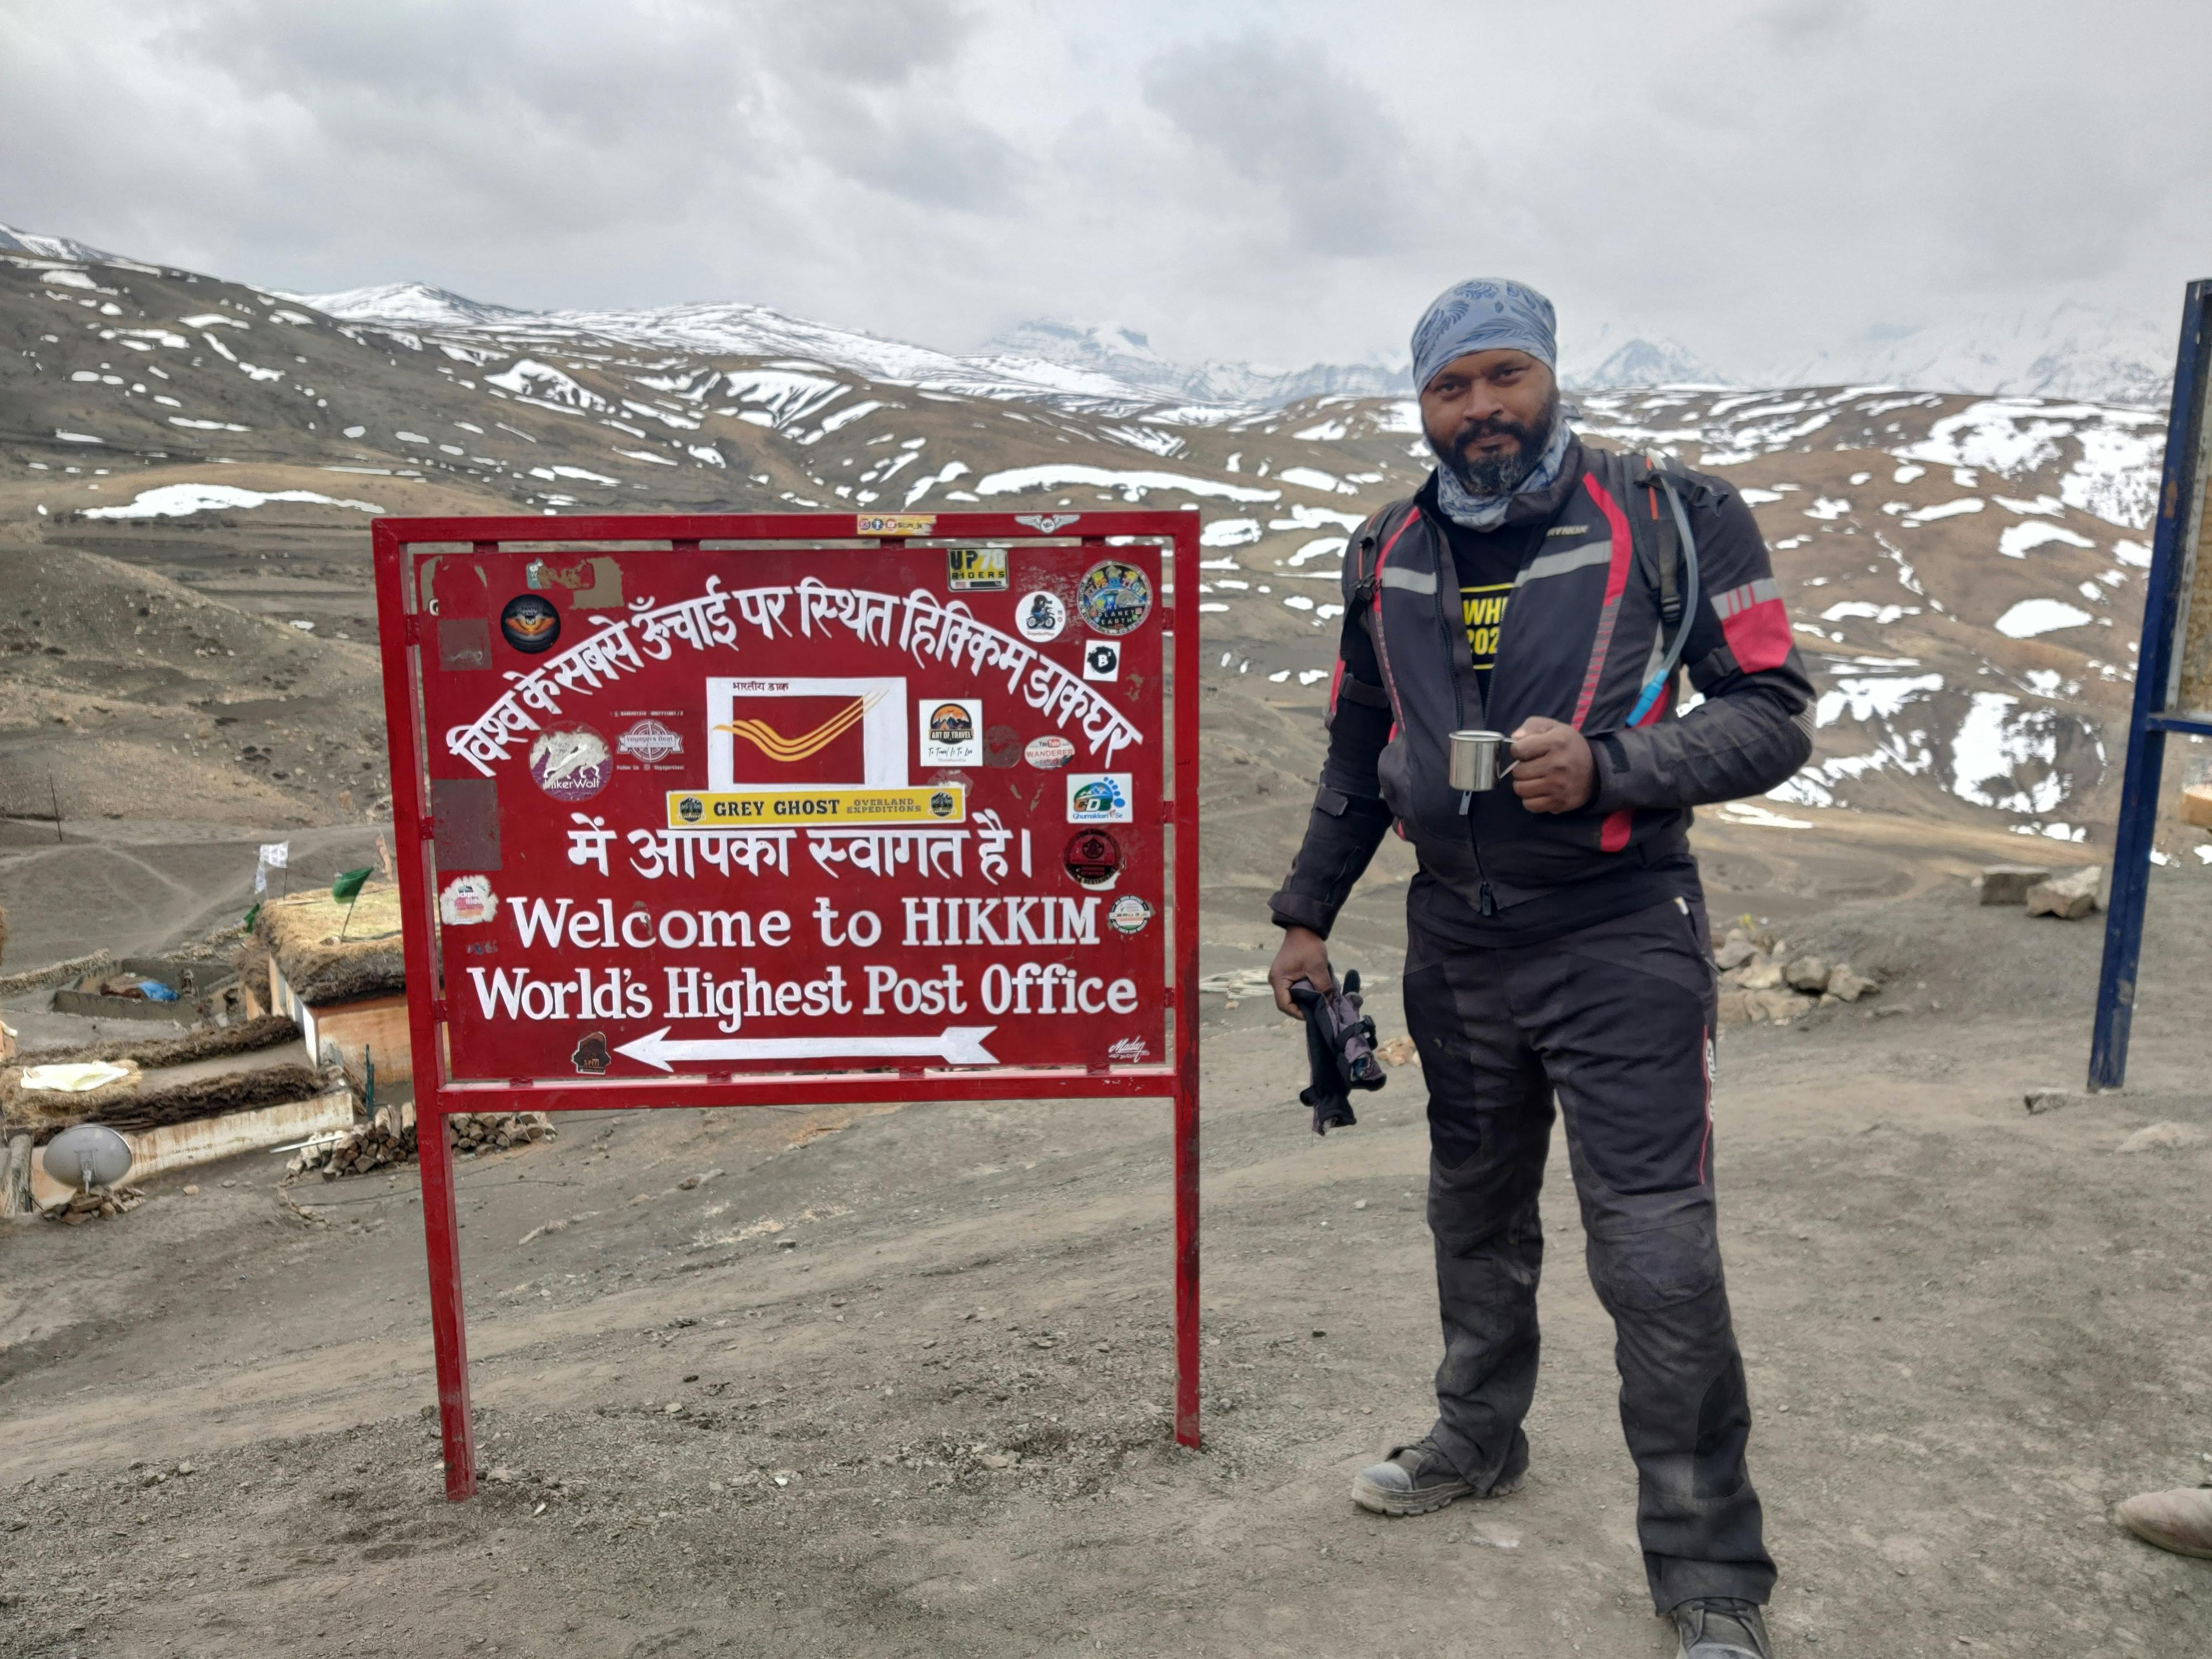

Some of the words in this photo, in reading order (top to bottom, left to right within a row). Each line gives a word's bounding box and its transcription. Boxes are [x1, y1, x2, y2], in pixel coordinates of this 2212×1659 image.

[446, 690, 541, 777] विश्व
[731, 586, 793, 640] पर
[795, 576, 901, 646] स्थित
[899, 589, 1037, 695] हिक्किम
[1024, 654, 1144, 769] डाकघर
[733, 681, 765, 691] भारतीय
[768, 682, 789, 691] डाक
[627, 735, 656, 744] Voyagers
[931, 731, 942, 739] ART
[943, 731, 951, 739] OF
[951, 731, 972, 739] TRAVEL
[1026, 749, 1073, 758] WANDERER
[713, 801, 764, 817] GREY
[774, 800, 840, 816] GHOST
[847, 805, 922, 813] EXPEDITIONS
[567, 812, 617, 877] में
[627, 829, 797, 879] आपका
[806, 829, 971, 879] स्वागत
[506, 897, 791, 949] Welcome
[812, 897, 881, 947] to
[901, 896, 1101, 946] HIKKIM
[466, 967, 653, 1020] World's
[663, 966, 852, 1033] Highest
[863, 964, 967, 1015] Post
[981, 962, 1138, 1015] Office
